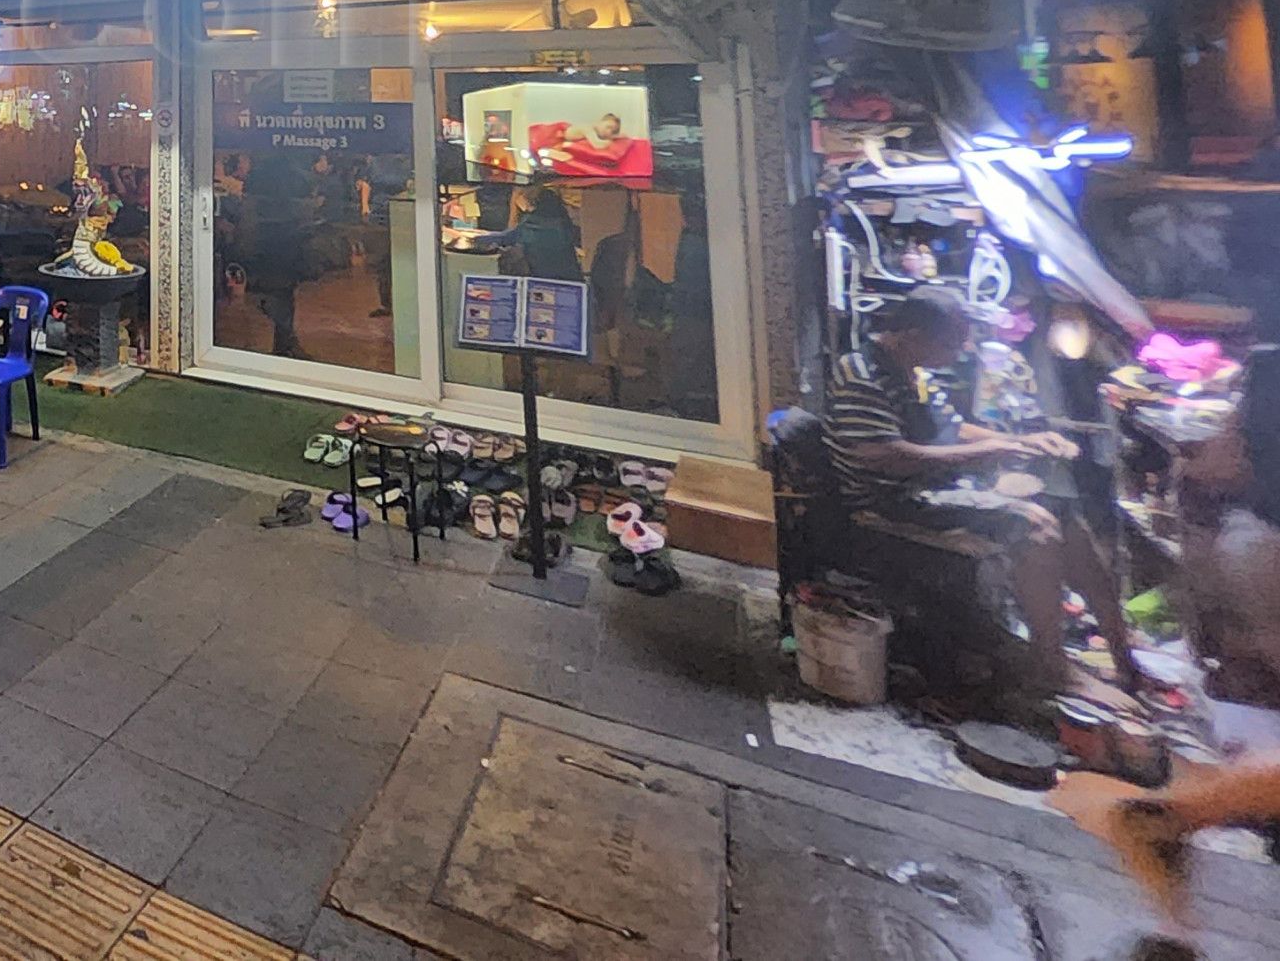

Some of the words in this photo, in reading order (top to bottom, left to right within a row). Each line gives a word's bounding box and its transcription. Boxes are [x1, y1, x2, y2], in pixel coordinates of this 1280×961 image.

[373, 114, 386, 130] 3
[272, 134, 282, 146] P
[284, 136, 337, 150] Massage
[340, 136, 348, 148] 3
